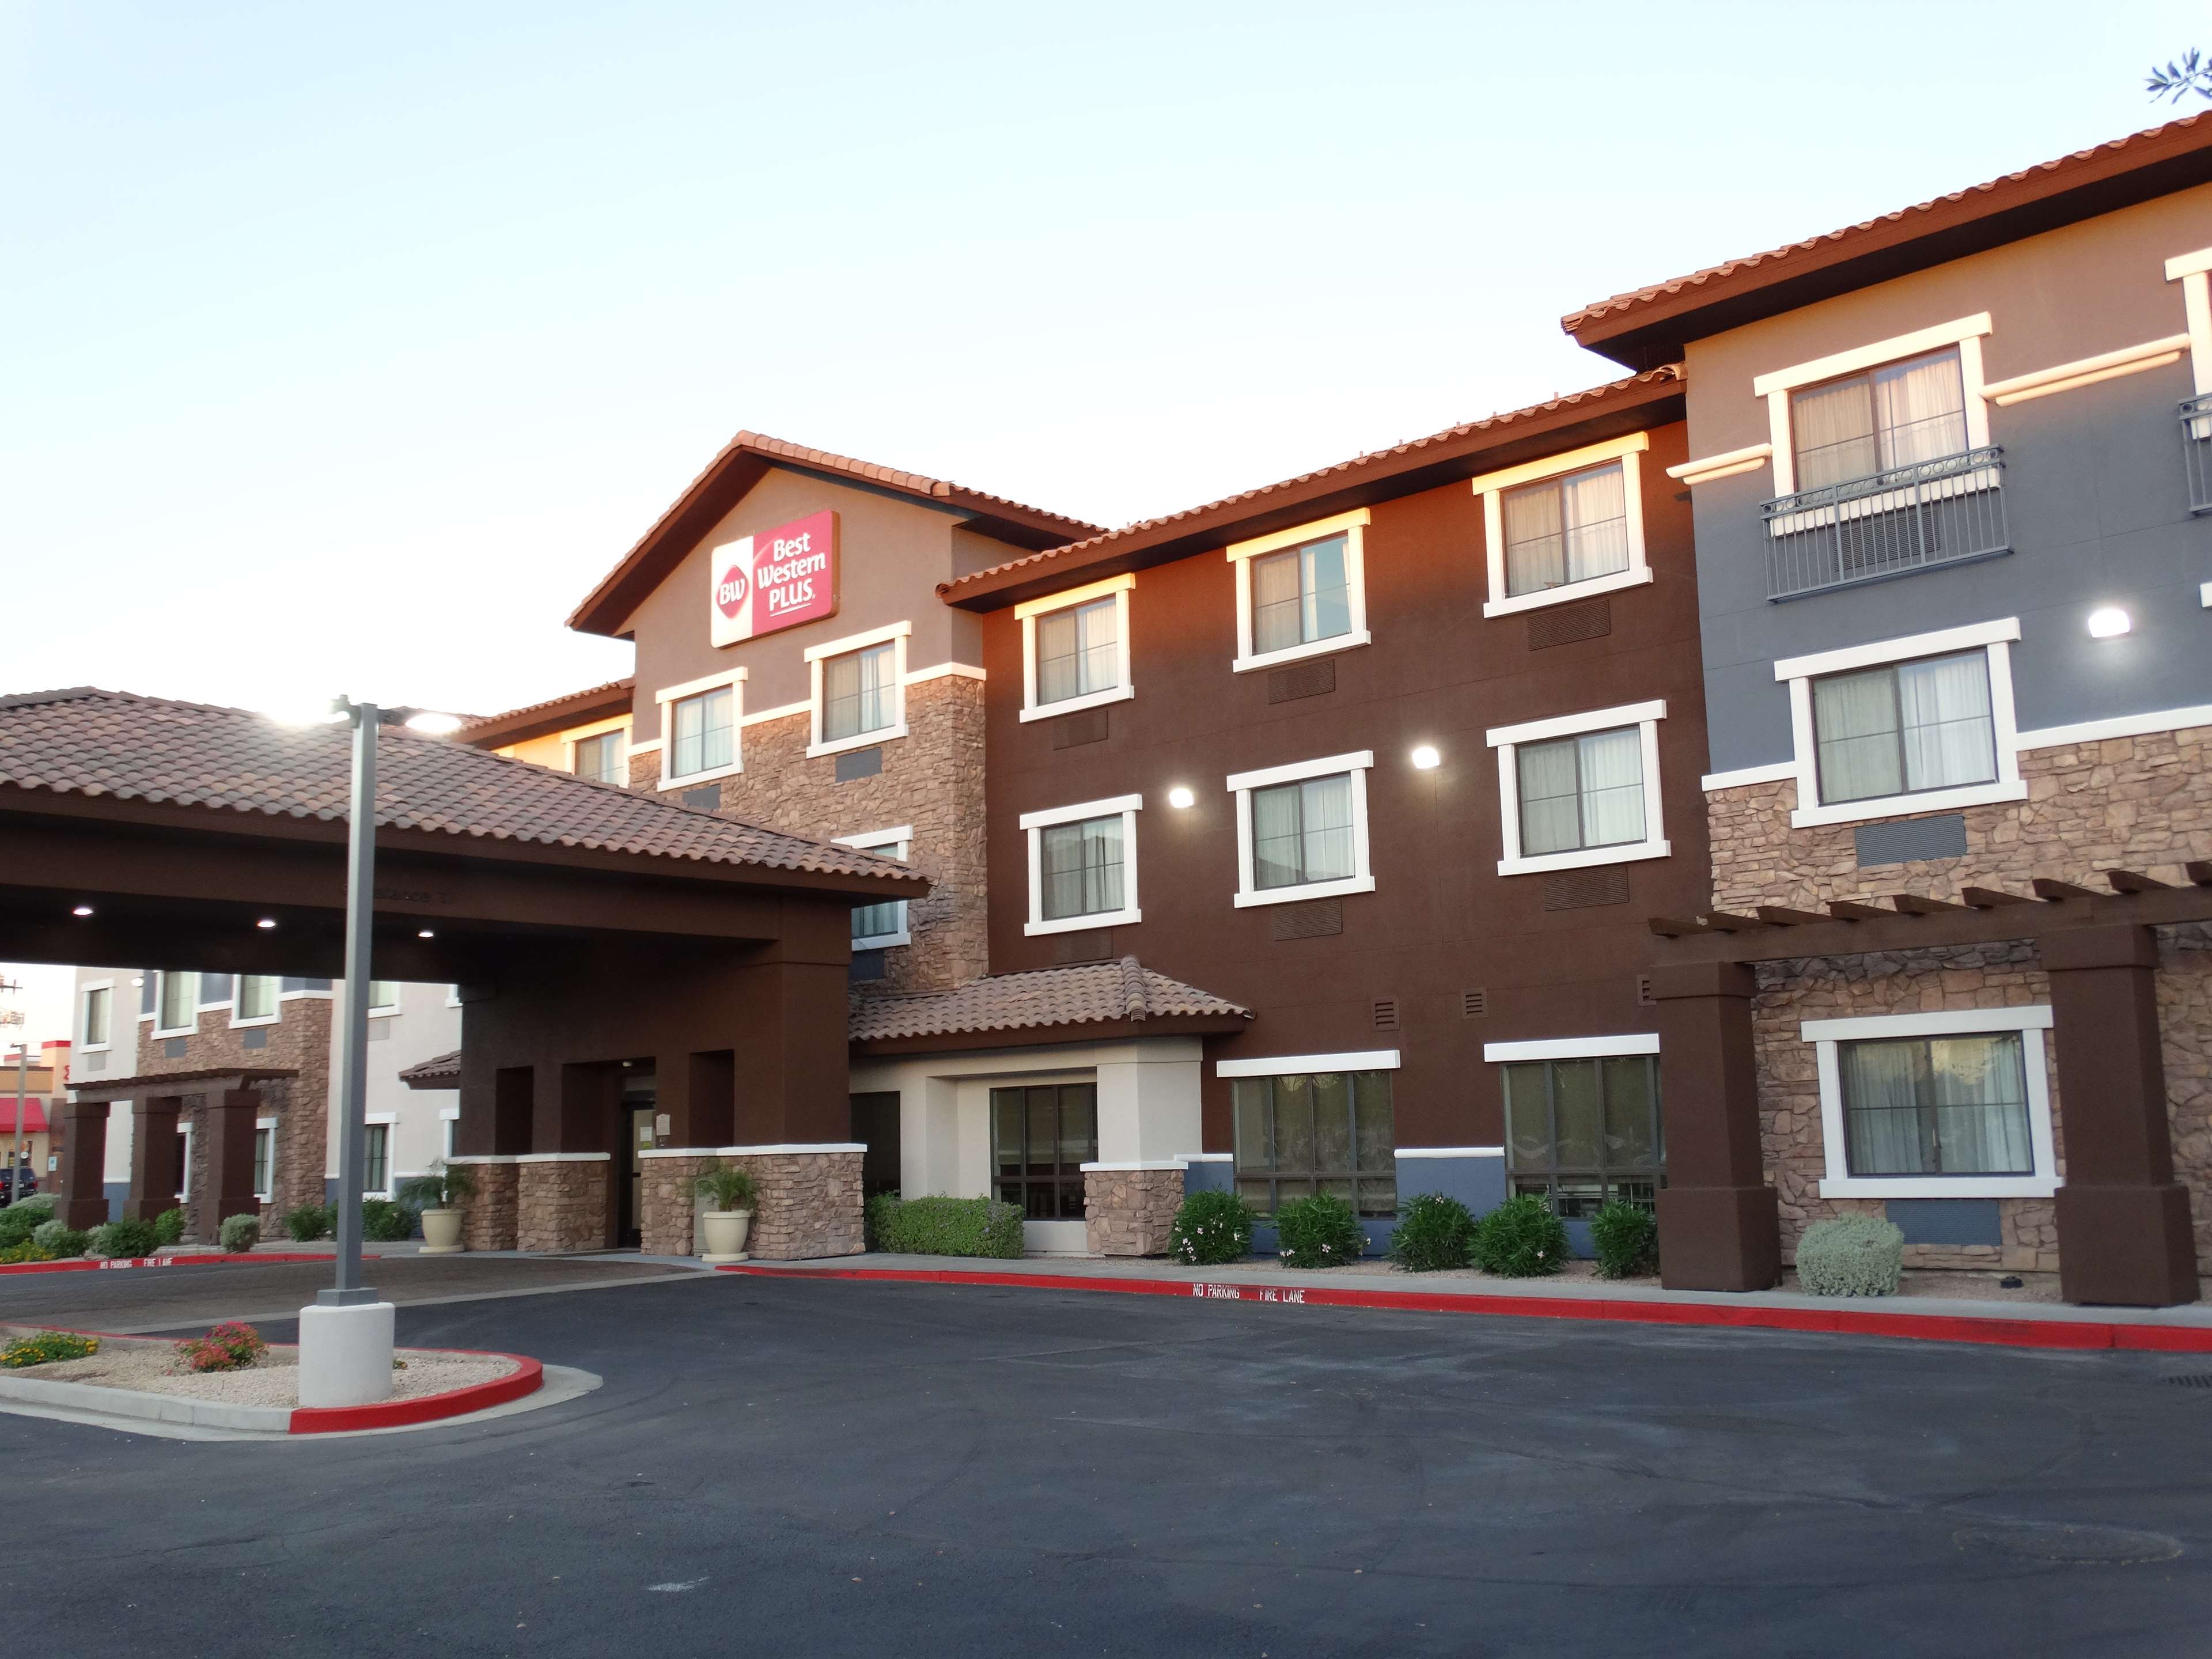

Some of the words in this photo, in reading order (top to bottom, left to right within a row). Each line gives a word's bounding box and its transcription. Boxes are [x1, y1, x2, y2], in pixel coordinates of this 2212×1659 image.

[773, 532, 811, 563] Best
[757, 552, 826, 590] Western
[719, 578, 745, 605] BW
[100, 1261, 108, 1270] NO
[110, 1260, 132, 1269] PARKING
[1192, 1283, 1203, 1297] NO
[1207, 1284, 1240, 1299] PARKING
[1259, 1288, 1278, 1302] FIRE
[1282, 1290, 1305, 1304] LANE
